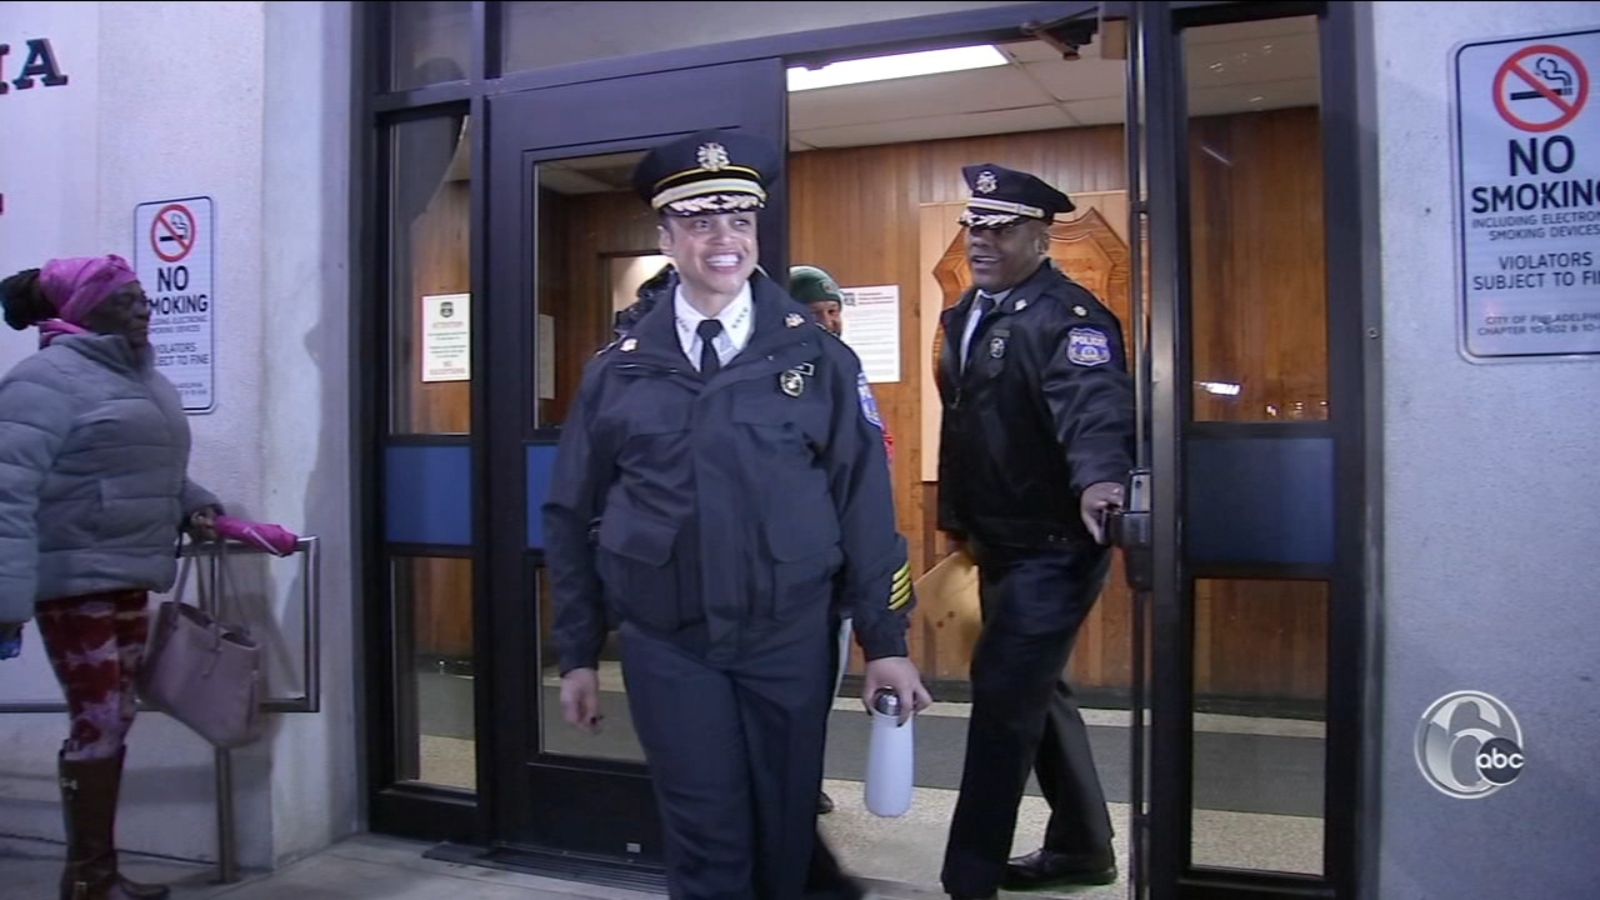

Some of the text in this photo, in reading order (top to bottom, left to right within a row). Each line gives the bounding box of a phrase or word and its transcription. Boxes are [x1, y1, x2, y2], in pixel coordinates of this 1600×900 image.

[1509, 134, 1575, 177] NO
[1471, 179, 1600, 214] SMOKIN
[1471, 214, 1537, 229] INCLUDING
[1489, 227, 1546, 241] SMOKING
[1498, 251, 1594, 270] VIOLATORS
[157, 265, 189, 292] NO
[1473, 270, 1600, 291] SUBJECT TO FI
[147, 294, 208, 315] MOKING
